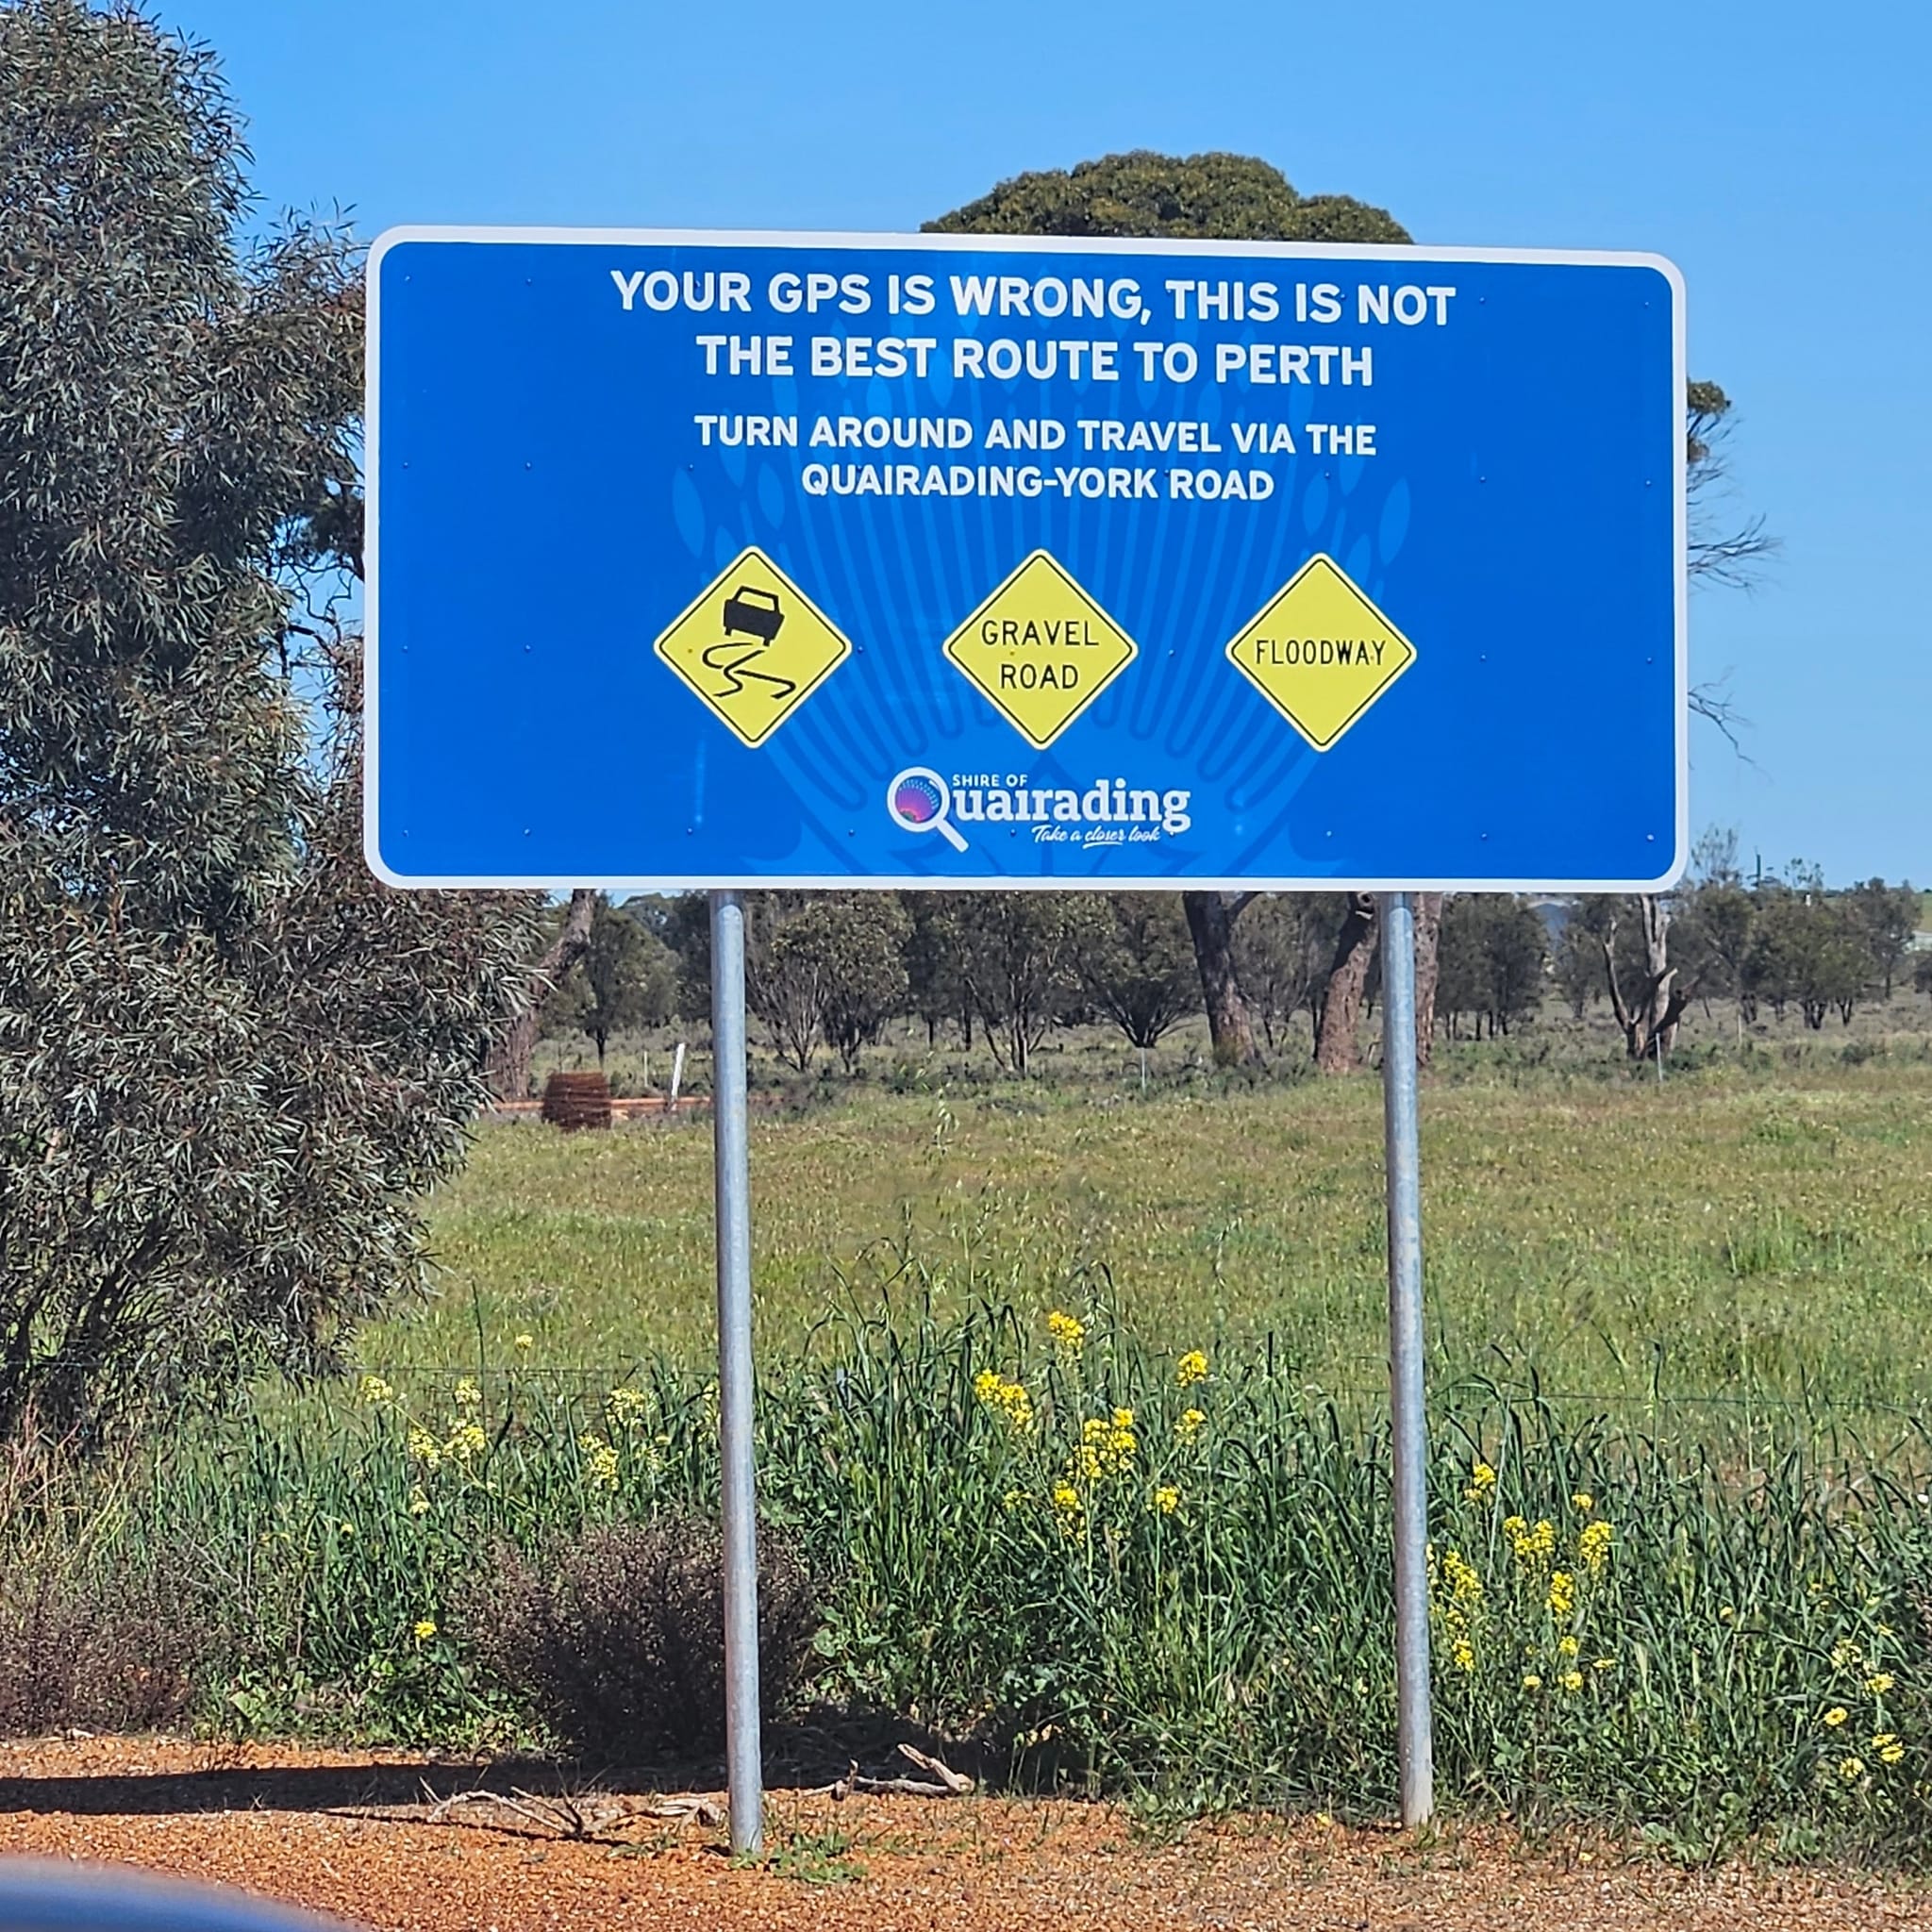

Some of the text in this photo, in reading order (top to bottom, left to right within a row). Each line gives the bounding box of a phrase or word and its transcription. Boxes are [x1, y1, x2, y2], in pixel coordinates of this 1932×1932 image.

[610, 270, 1457, 325] YOUR GPS IS WRONG, THIS IS NOT
[696, 335, 1373, 386] THE BEST ROUTE TO PERTH
[694, 415, 1376, 456] TURN AROUND AND TRAVEL VIA THE
[802, 463, 1274, 500] QUAIRADING-YORK ROAD
[981, 620, 1100, 646] GRAVEL
[1256, 640, 1386, 666] FLOODWAY
[1001, 663, 1078, 690] ROAD
[952, 774, 1028, 787] SHIRE OF
[1031, 824, 1161, 842] Take a closer look
